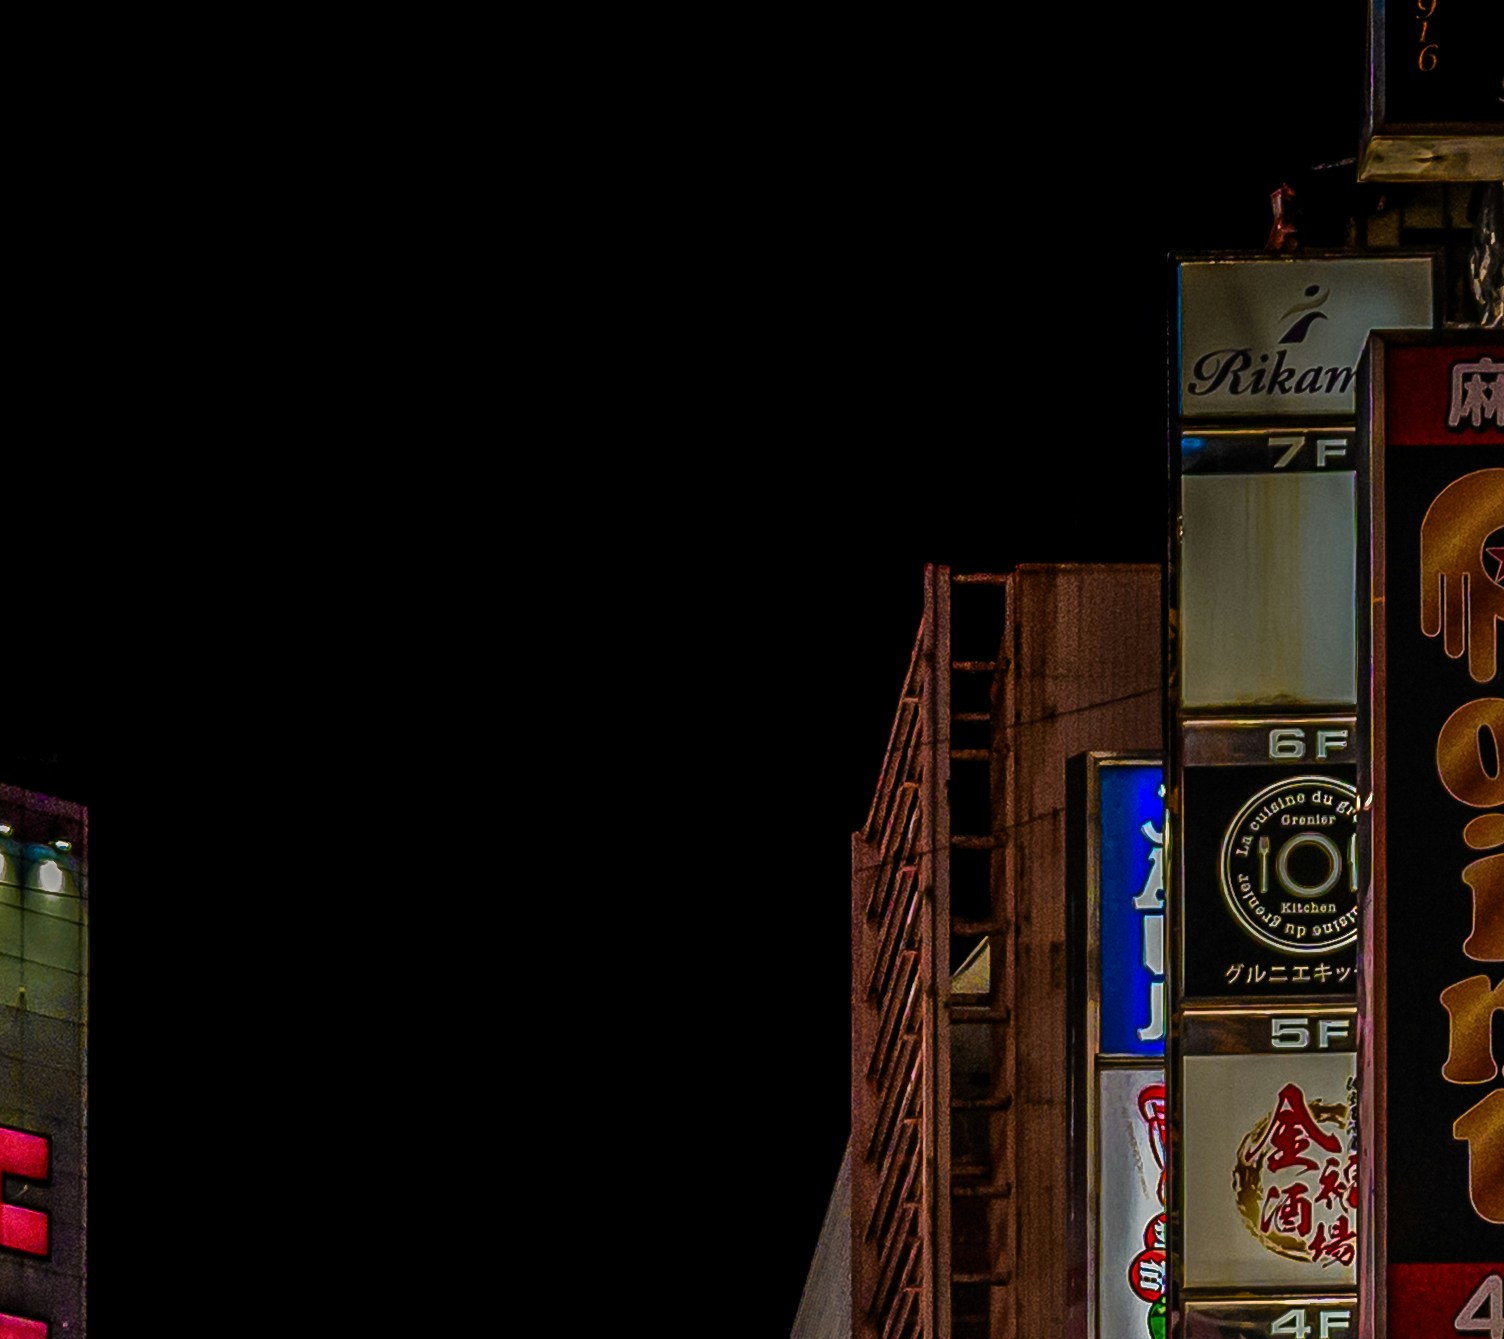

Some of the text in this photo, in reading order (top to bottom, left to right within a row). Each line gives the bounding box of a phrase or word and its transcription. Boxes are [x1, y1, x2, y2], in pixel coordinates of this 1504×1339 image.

[1267, 436, 1349, 470] 7F
[1268, 728, 1349, 760] 6F
[1281, 813, 1337, 826] Grenier
[1281, 901, 1337, 915] Kitchen
[1270, 1018, 1351, 1049] 5F
